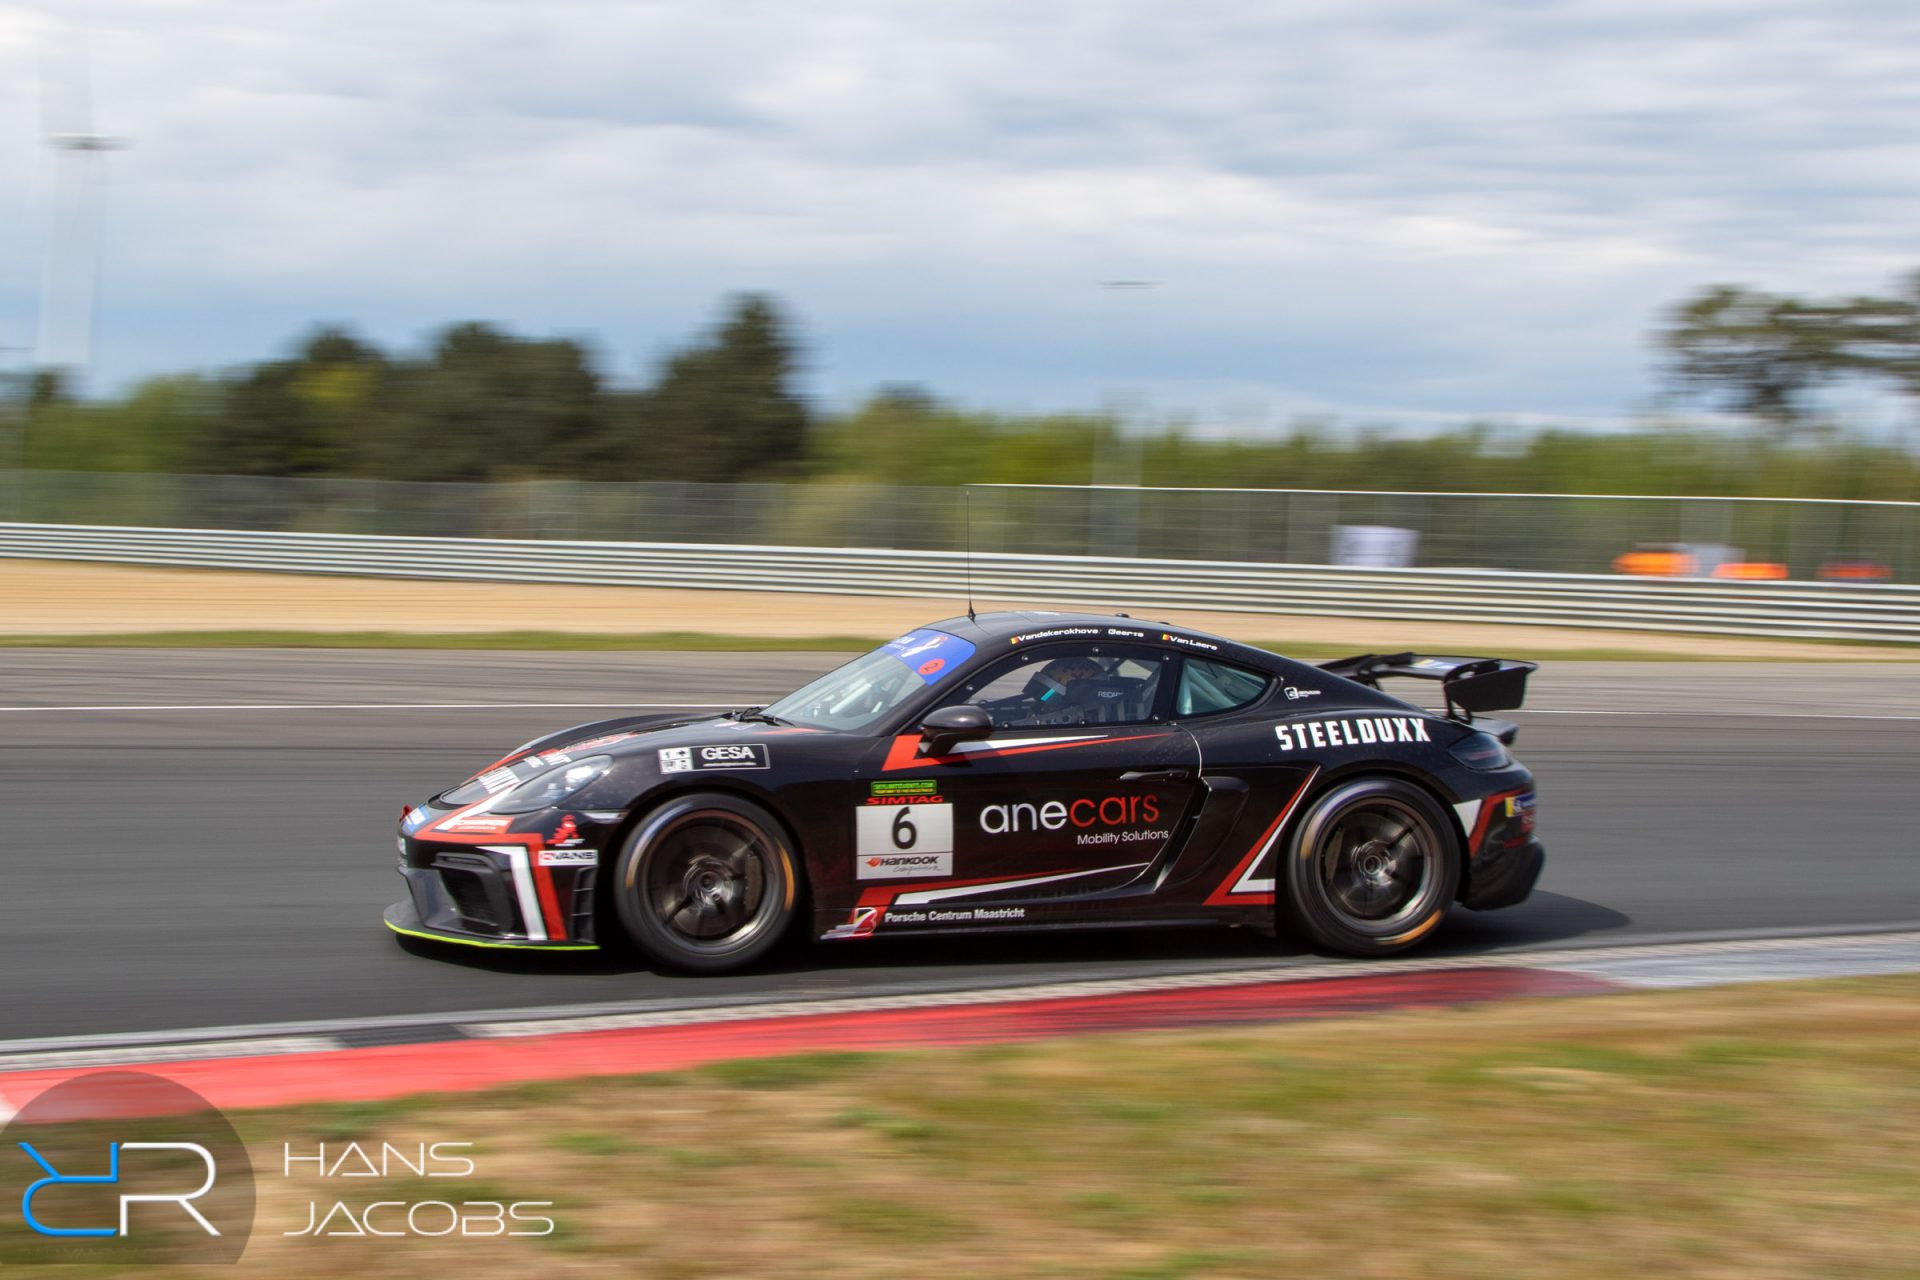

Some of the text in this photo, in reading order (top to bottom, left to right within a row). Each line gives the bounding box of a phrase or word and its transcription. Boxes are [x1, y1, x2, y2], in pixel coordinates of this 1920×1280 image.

[1274, 717, 1432, 751] STEELDUXX
[701, 746, 756, 760] GESA
[866, 795, 945, 806] SIMTAG
[892, 806, 917, 850] 6
[1077, 829, 1169, 845] Mobility Solutions
[884, 908, 1025, 923] Porsche Centrum Maastricht
